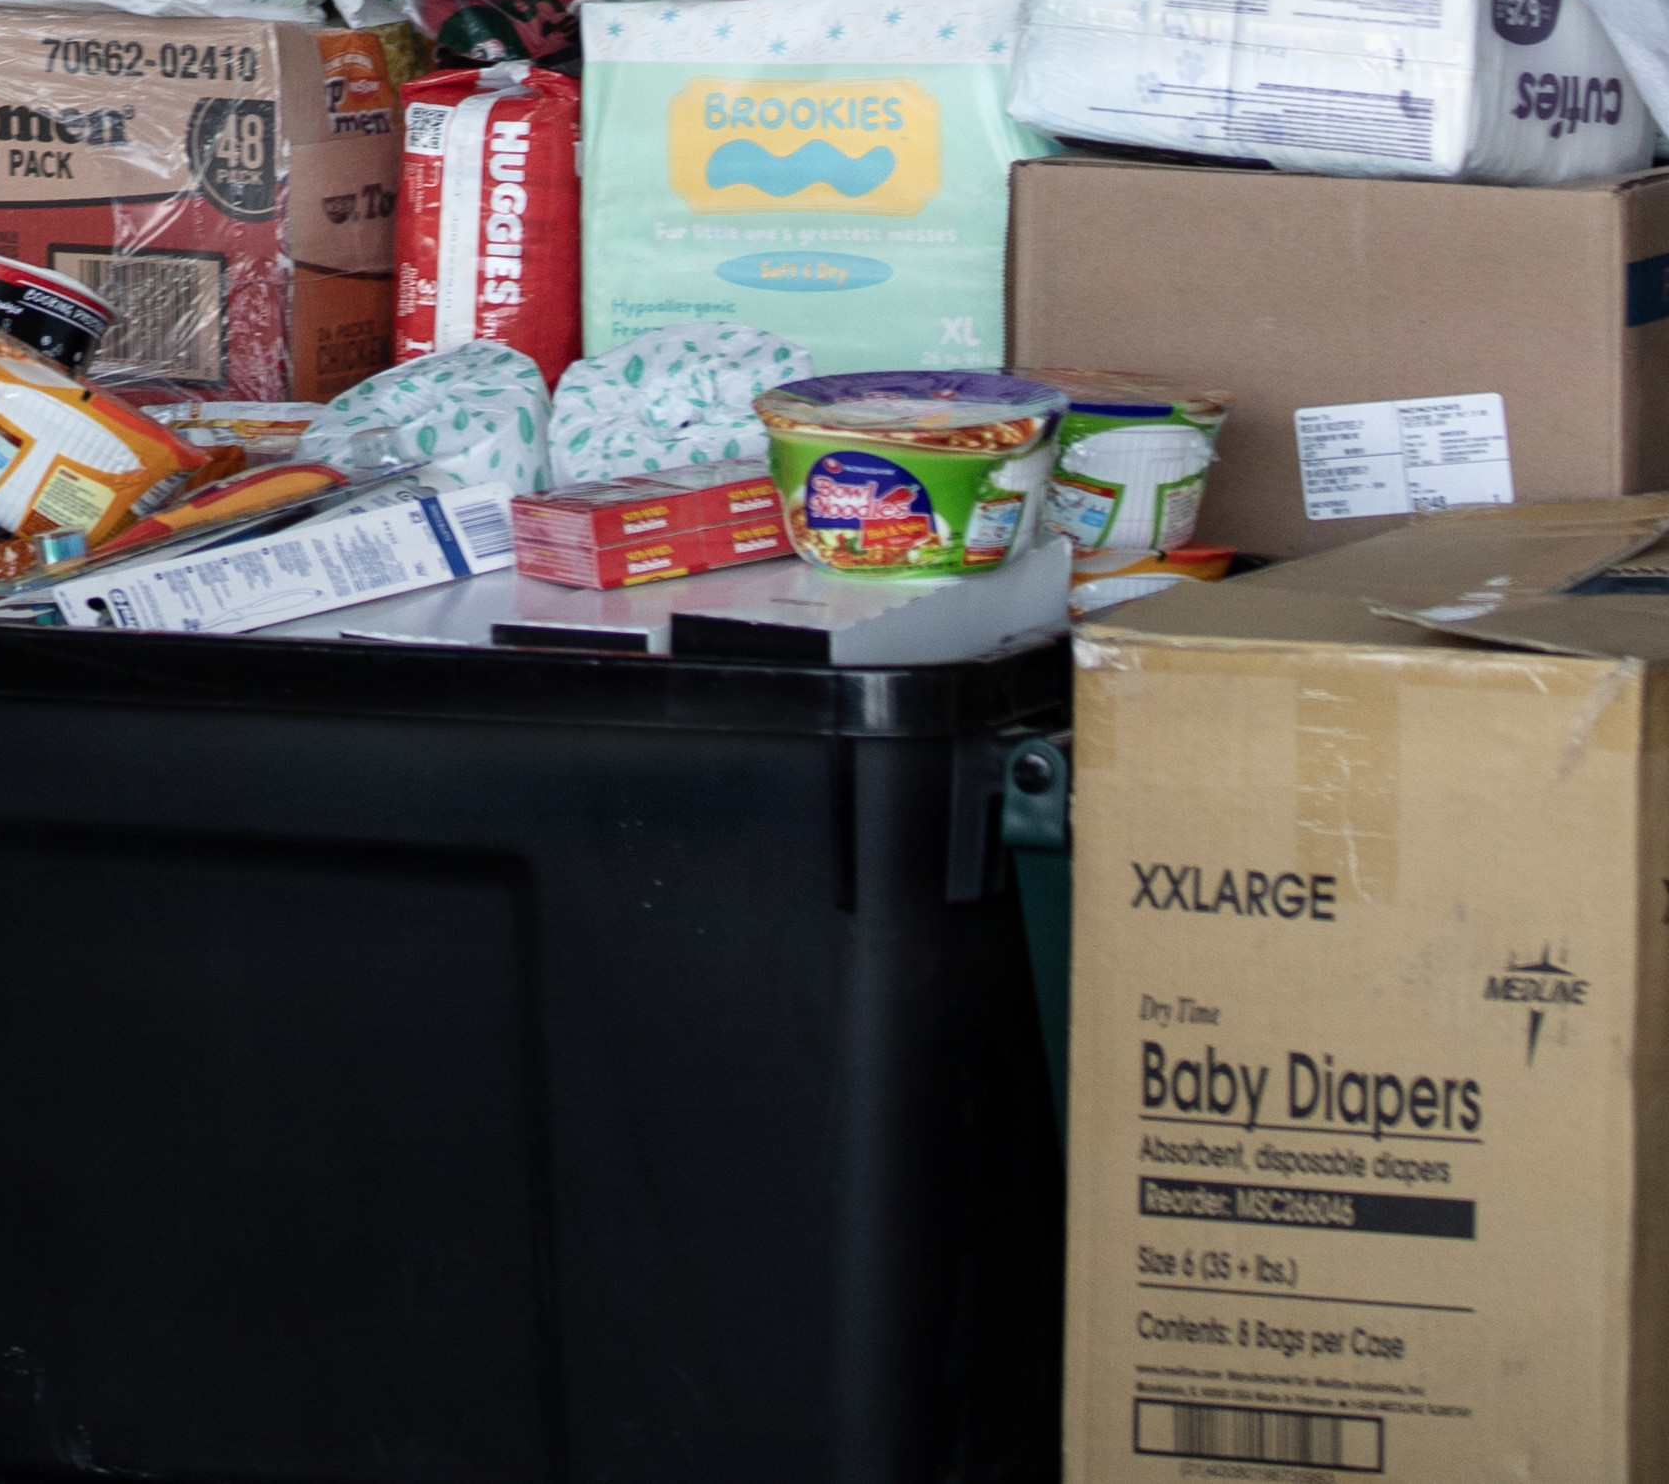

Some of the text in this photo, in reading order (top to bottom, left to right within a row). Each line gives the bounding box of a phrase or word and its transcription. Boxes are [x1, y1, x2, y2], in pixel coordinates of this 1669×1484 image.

[41, 39, 258, 82] 70662-02410
[704, 92, 905, 132] BROOKIES
[1512, 70, 1623, 139] cuties
[215, 112, 264, 171] 48
[8, 147, 75, 180] PACK
[482, 120, 531, 308] HUGGIES
[654, 221, 686, 243] For
[691, 220, 739, 243] little
[797, 220, 873, 246] greatest
[877, 224, 959, 244] messes
[760, 258, 848, 288] Soft Dry
[610, 297, 738, 317] Hypoallergenic
[938, 315, 981, 349] XL
[808, 494, 913, 520] Noodles
[811, 476, 879, 500] Bowl
[1130, 860, 1337, 922] XXLARGE
[1482, 974, 1589, 1008] MEDLINE
[1139, 993, 1221, 1029] Dry Time
[1141, 1039, 1483, 1142] Baby Diapers
[1138, 1135, 1452, 1187] Absorbent, disposable diapers
[1143, 1181, 1234, 1218] Reorder:
[1137, 1244, 1300, 1288] Size 6 (35 + lbs.)
[1136, 1309, 1407, 1361] Contents: 8 Bags per Case
